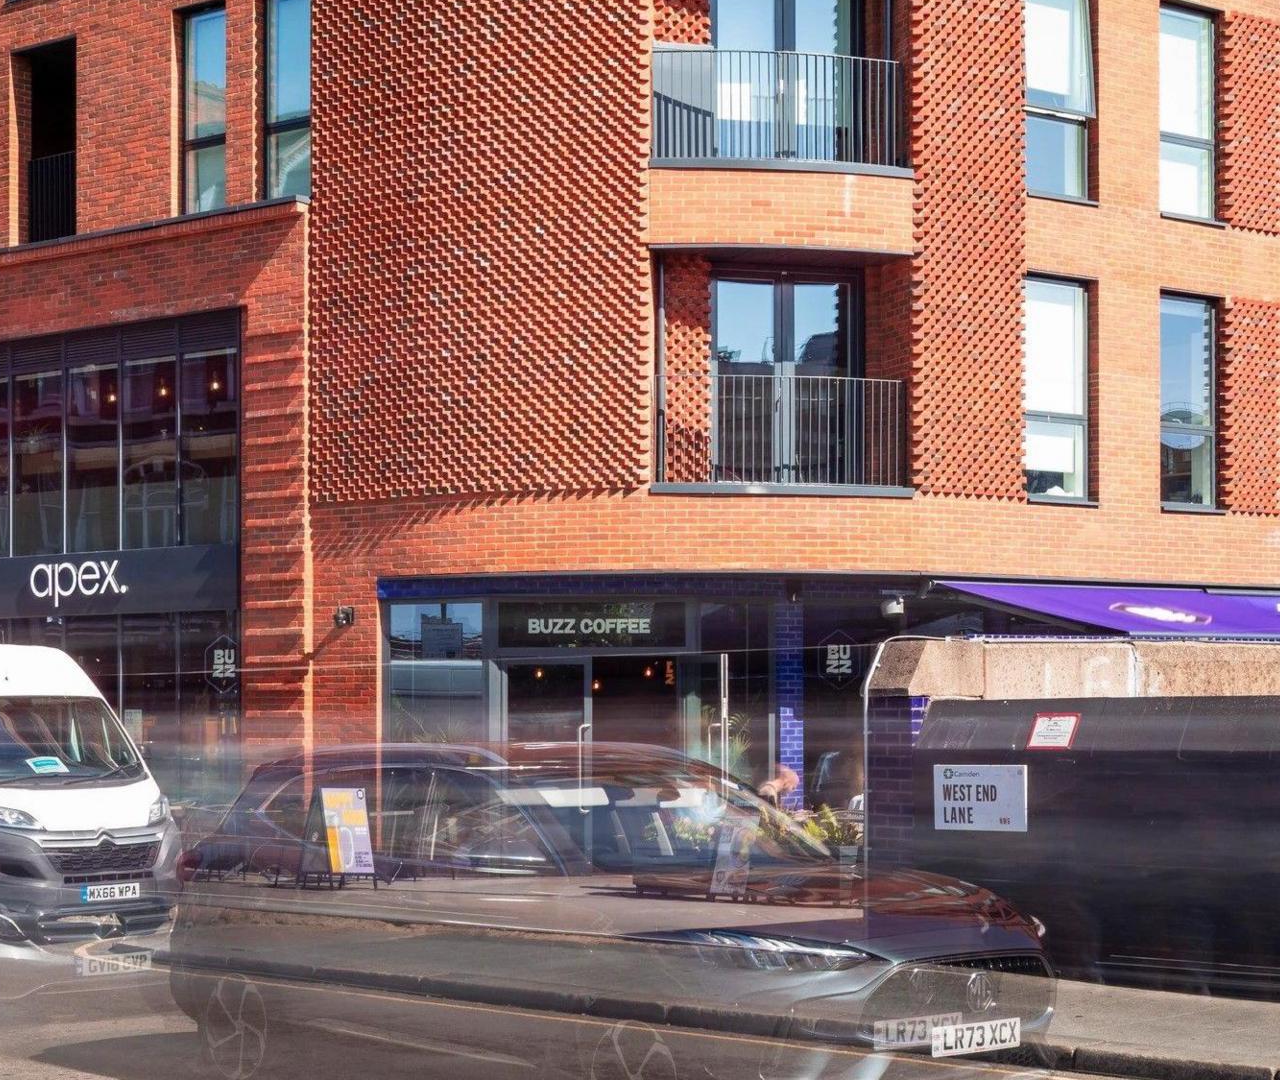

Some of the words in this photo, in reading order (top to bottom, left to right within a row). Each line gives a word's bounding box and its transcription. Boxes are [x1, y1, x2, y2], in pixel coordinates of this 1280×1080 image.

[29, 558, 130, 608] apex.
[527, 618, 576, 635] BUZZ
[579, 618, 652, 635] COFFEE
[953, 770, 981, 778] Camden
[942, 784, 973, 802] WEST
[975, 784, 997, 802] END
[943, 807, 974, 824] LANE
[88, 886, 115, 900] MX66
[118, 885, 137, 897] WPA
[884, 1020, 928, 1042] LR73
[943, 1025, 985, 1051] LR73
[989, 1021, 1017, 1045] XCX
